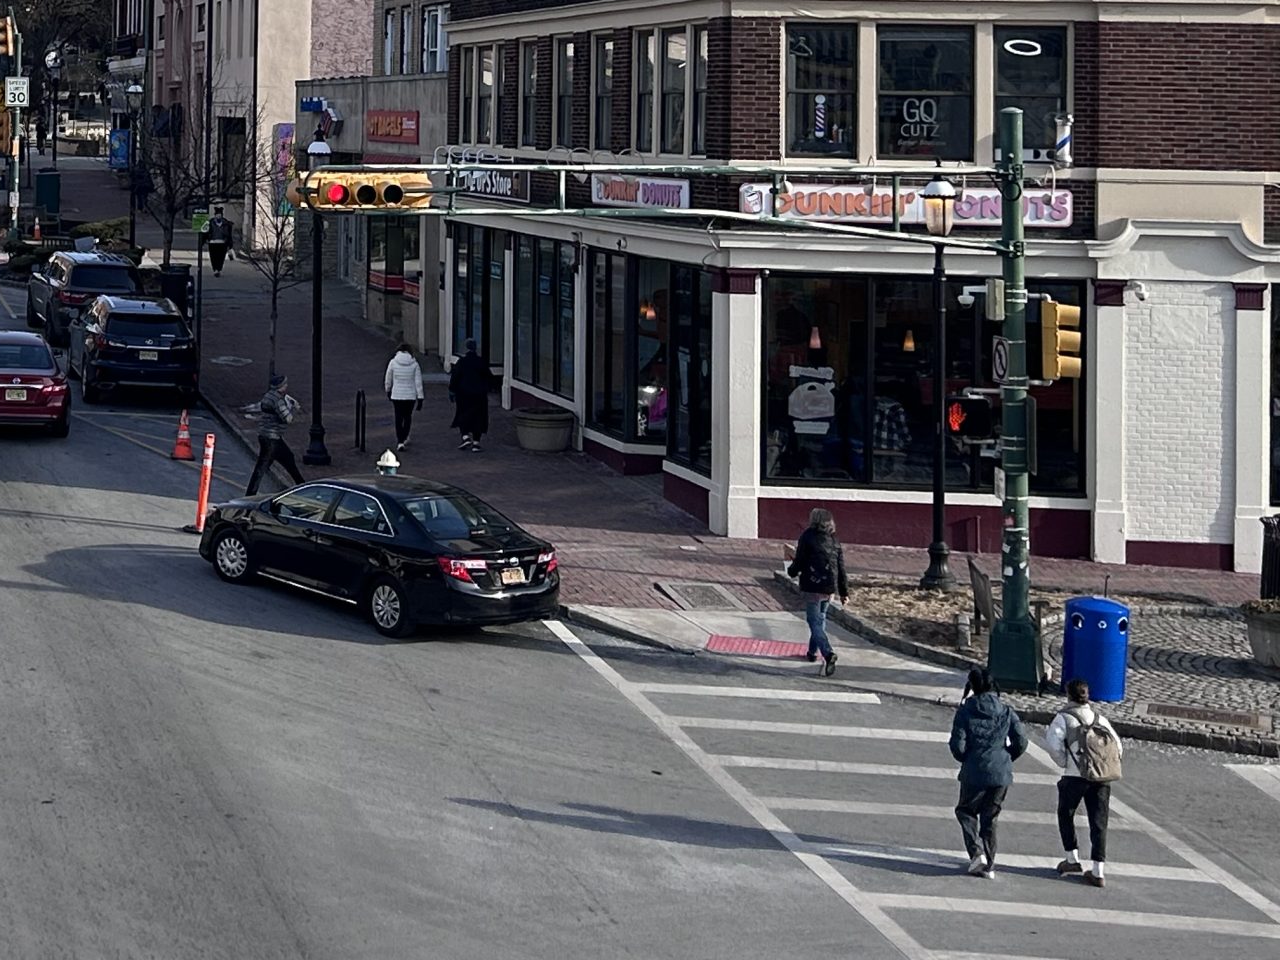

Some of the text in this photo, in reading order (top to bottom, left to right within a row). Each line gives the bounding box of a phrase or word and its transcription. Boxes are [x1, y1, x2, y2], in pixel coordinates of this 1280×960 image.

[8, 92, 26, 103] 30
[903, 98, 937, 124] GQ
[900, 123, 940, 137] CUTZ
[491, 170, 511, 195] Store
[642, 183, 682, 207] DONUTS
